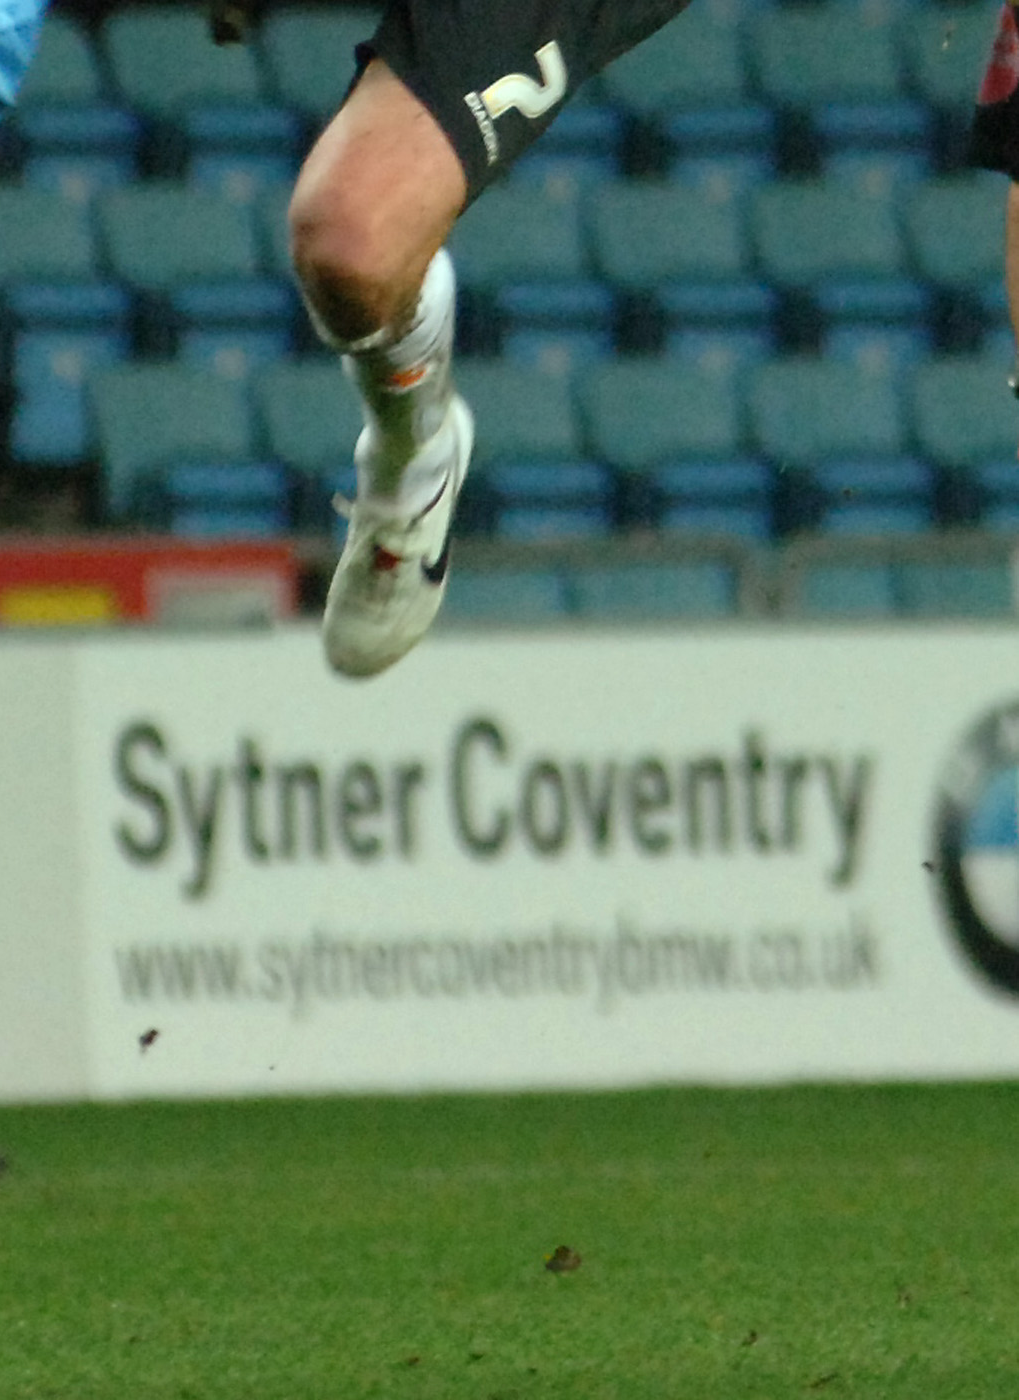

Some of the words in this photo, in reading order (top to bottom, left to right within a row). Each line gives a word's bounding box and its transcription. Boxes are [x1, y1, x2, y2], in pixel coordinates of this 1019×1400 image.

[480, 39, 568, 119] 2
[113, 717, 427, 899] Sytner
[449, 712, 874, 886] Coventry
[114, 914, 880, 1018] www.sytnercoventrybmw.co.uk
